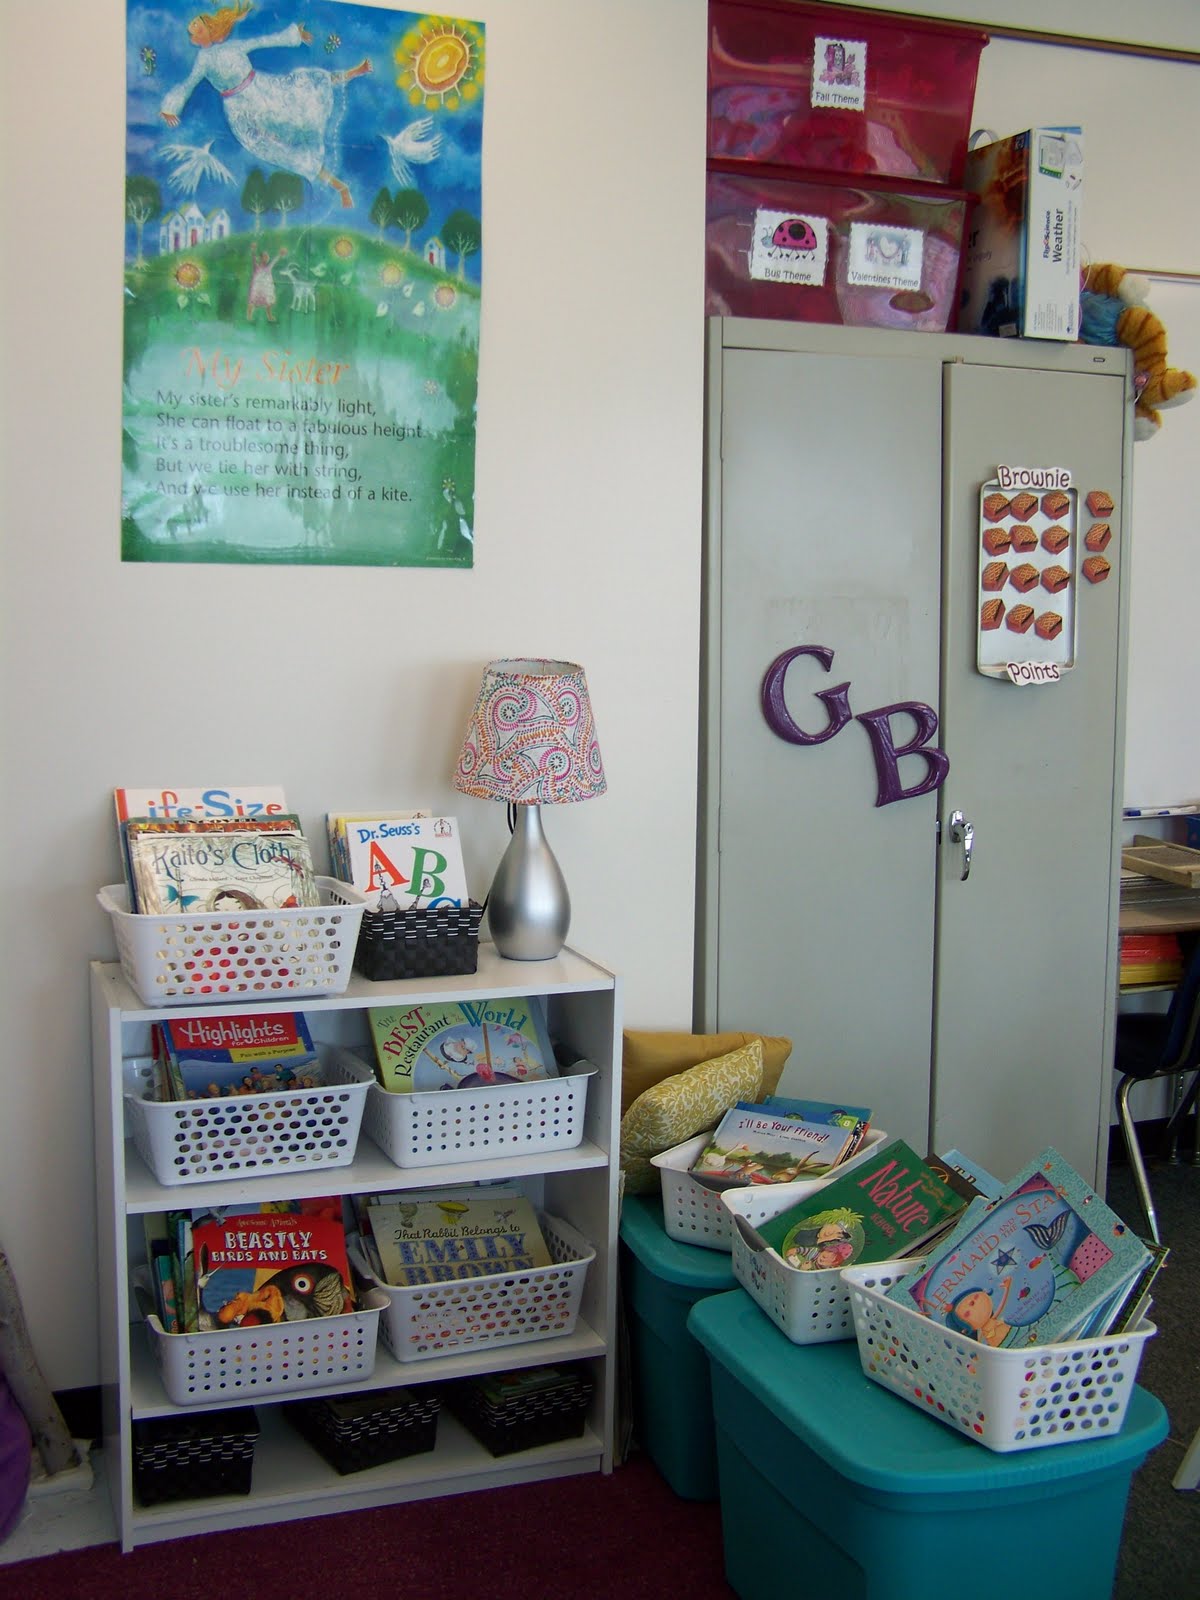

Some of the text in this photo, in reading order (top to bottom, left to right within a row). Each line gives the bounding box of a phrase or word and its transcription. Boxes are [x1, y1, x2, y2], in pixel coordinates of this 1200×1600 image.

[815, 91, 860, 104] Fall Theme
[1053, 208, 1064, 263] Weather
[765, 268, 812, 281] Bug Theme
[851, 271, 919, 288] Valentines Theme
[178, 347, 350, 391] My Sister
[156, 389, 376, 417] My sister's remarkably light,
[156, 412, 185, 429] She
[191, 418, 220, 430] can
[226, 415, 261, 431] float
[267, 418, 283, 433] to
[289, 422, 297, 433] a
[303, 418, 368, 437] fabulous
[157, 436, 349, 460] It's a troublesome thing,
[156, 458, 361, 482] But we tie her with string,
[999, 466, 1070, 488] Brownie
[156, 480, 188, 496] And
[223, 486, 250, 498] use
[255, 483, 281, 498] her
[287, 484, 341, 499] instead
[348, 486, 363, 501] of
[368, 490, 376, 501] a
[381, 487, 413, 502] kite.
[1008, 663, 1060, 683] Points
[357, 822, 421, 844] Dr. Seuss's
[152, 842, 293, 882] Kaito's Cloth
[457, 1001, 528, 1030] World
[179, 1019, 285, 1047] Highlights
[253, 1036, 290, 1045] Children
[382, 1005, 425, 1057] BEST
[394, 1013, 452, 1077] Restaurant
[738, 1118, 754, 1128] I'll
[756, 1121, 768, 1129] Be
[771, 1121, 793, 1132] Your
[793, 1126, 831, 1144] Friend!
[858, 1160, 930, 1233] Nature
[1015, 1184, 1069, 1226] STAR
[394, 1223, 521, 1240] That Rabbit Belongs to
[1000, 1217, 1016, 1234] AND
[1002, 1222, 1018, 1238] THE
[225, 1230, 313, 1250] BEASTLY
[393, 1232, 527, 1266] EMILY
[211, 1249, 328, 1262] BIRDS AND BATS
